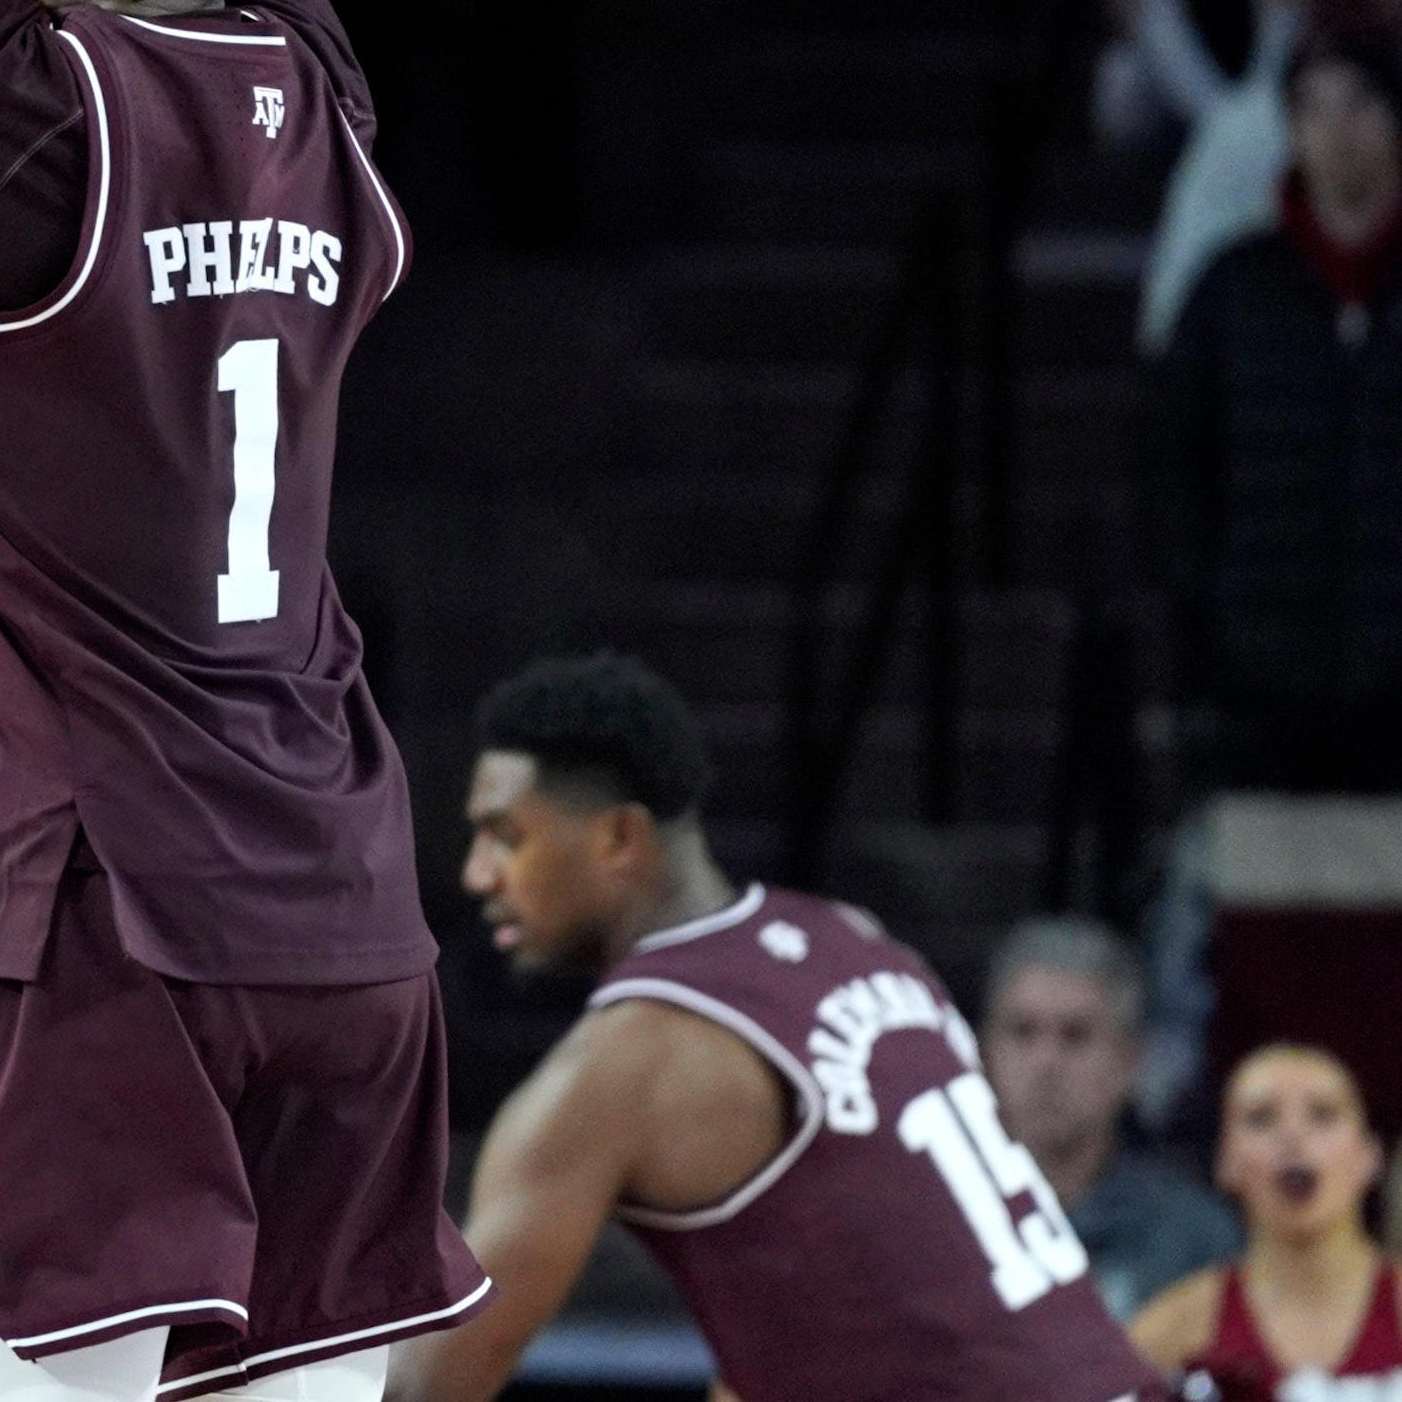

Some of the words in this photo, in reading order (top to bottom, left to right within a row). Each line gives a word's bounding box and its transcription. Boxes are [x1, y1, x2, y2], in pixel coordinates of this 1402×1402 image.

[143, 217, 343, 306] PHELPS
[217, 338, 279, 624] 1
[898, 1071, 1089, 1312] 15
